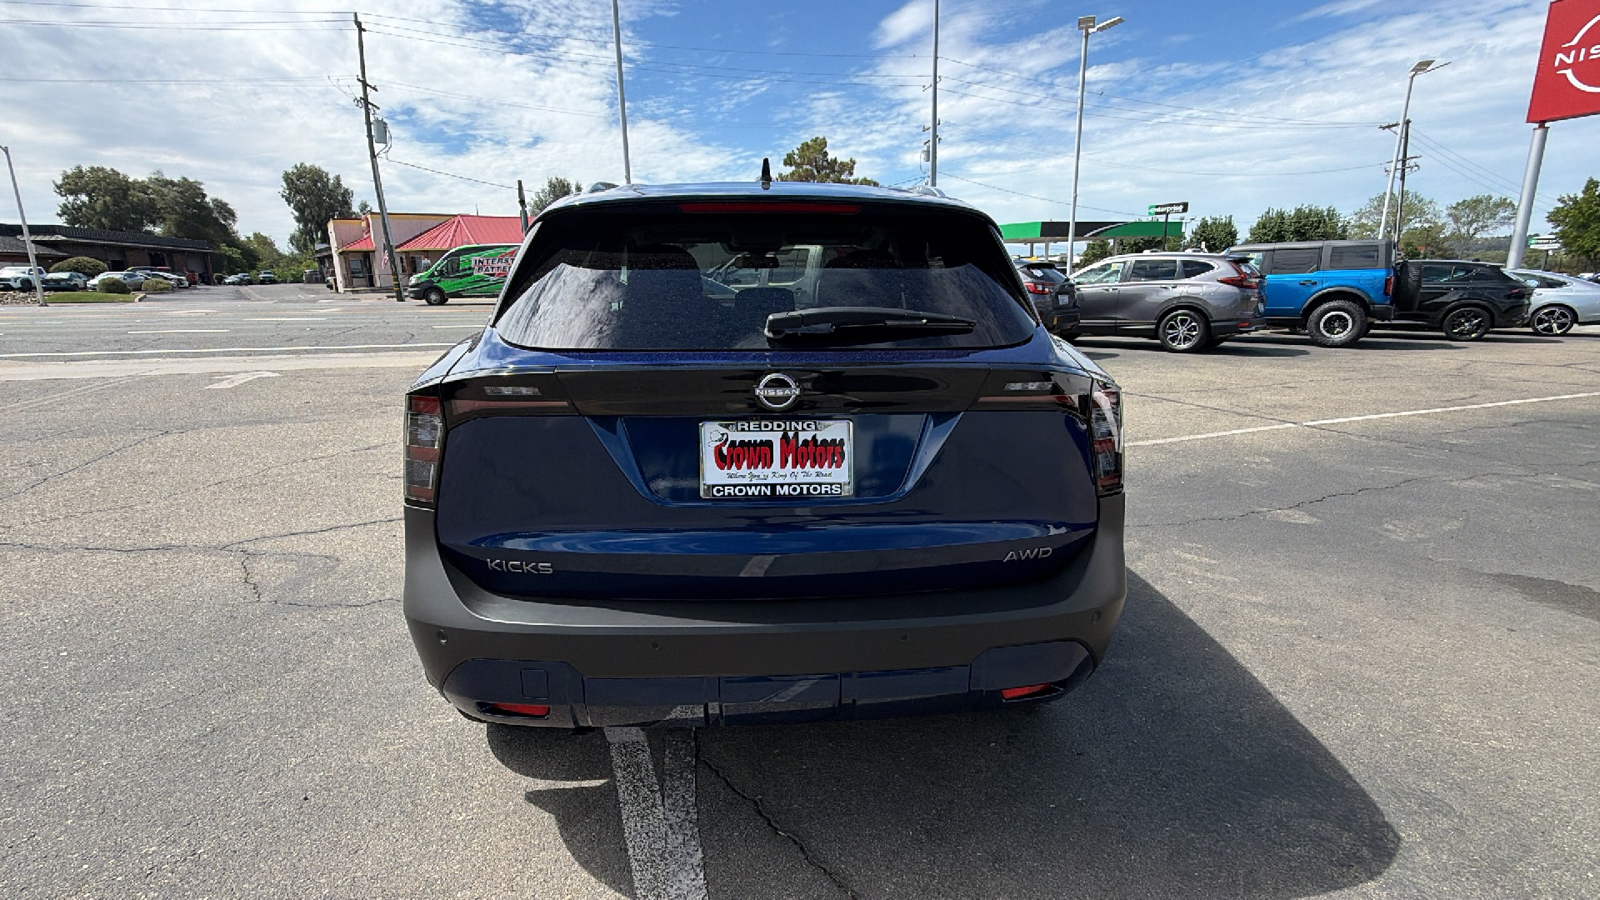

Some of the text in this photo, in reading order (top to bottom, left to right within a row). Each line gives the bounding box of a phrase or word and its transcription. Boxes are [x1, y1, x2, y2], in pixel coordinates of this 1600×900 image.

[755, 388, 800, 396] NISSAN
[737, 421, 816, 431] REDDING
[713, 433, 845, 470] Crown Motors
[771, 471, 787, 480] King
[712, 484, 842, 496] CROWN MOTORS
[1003, 547, 1053, 562] AWD
[486, 558, 553, 574] KICKS
